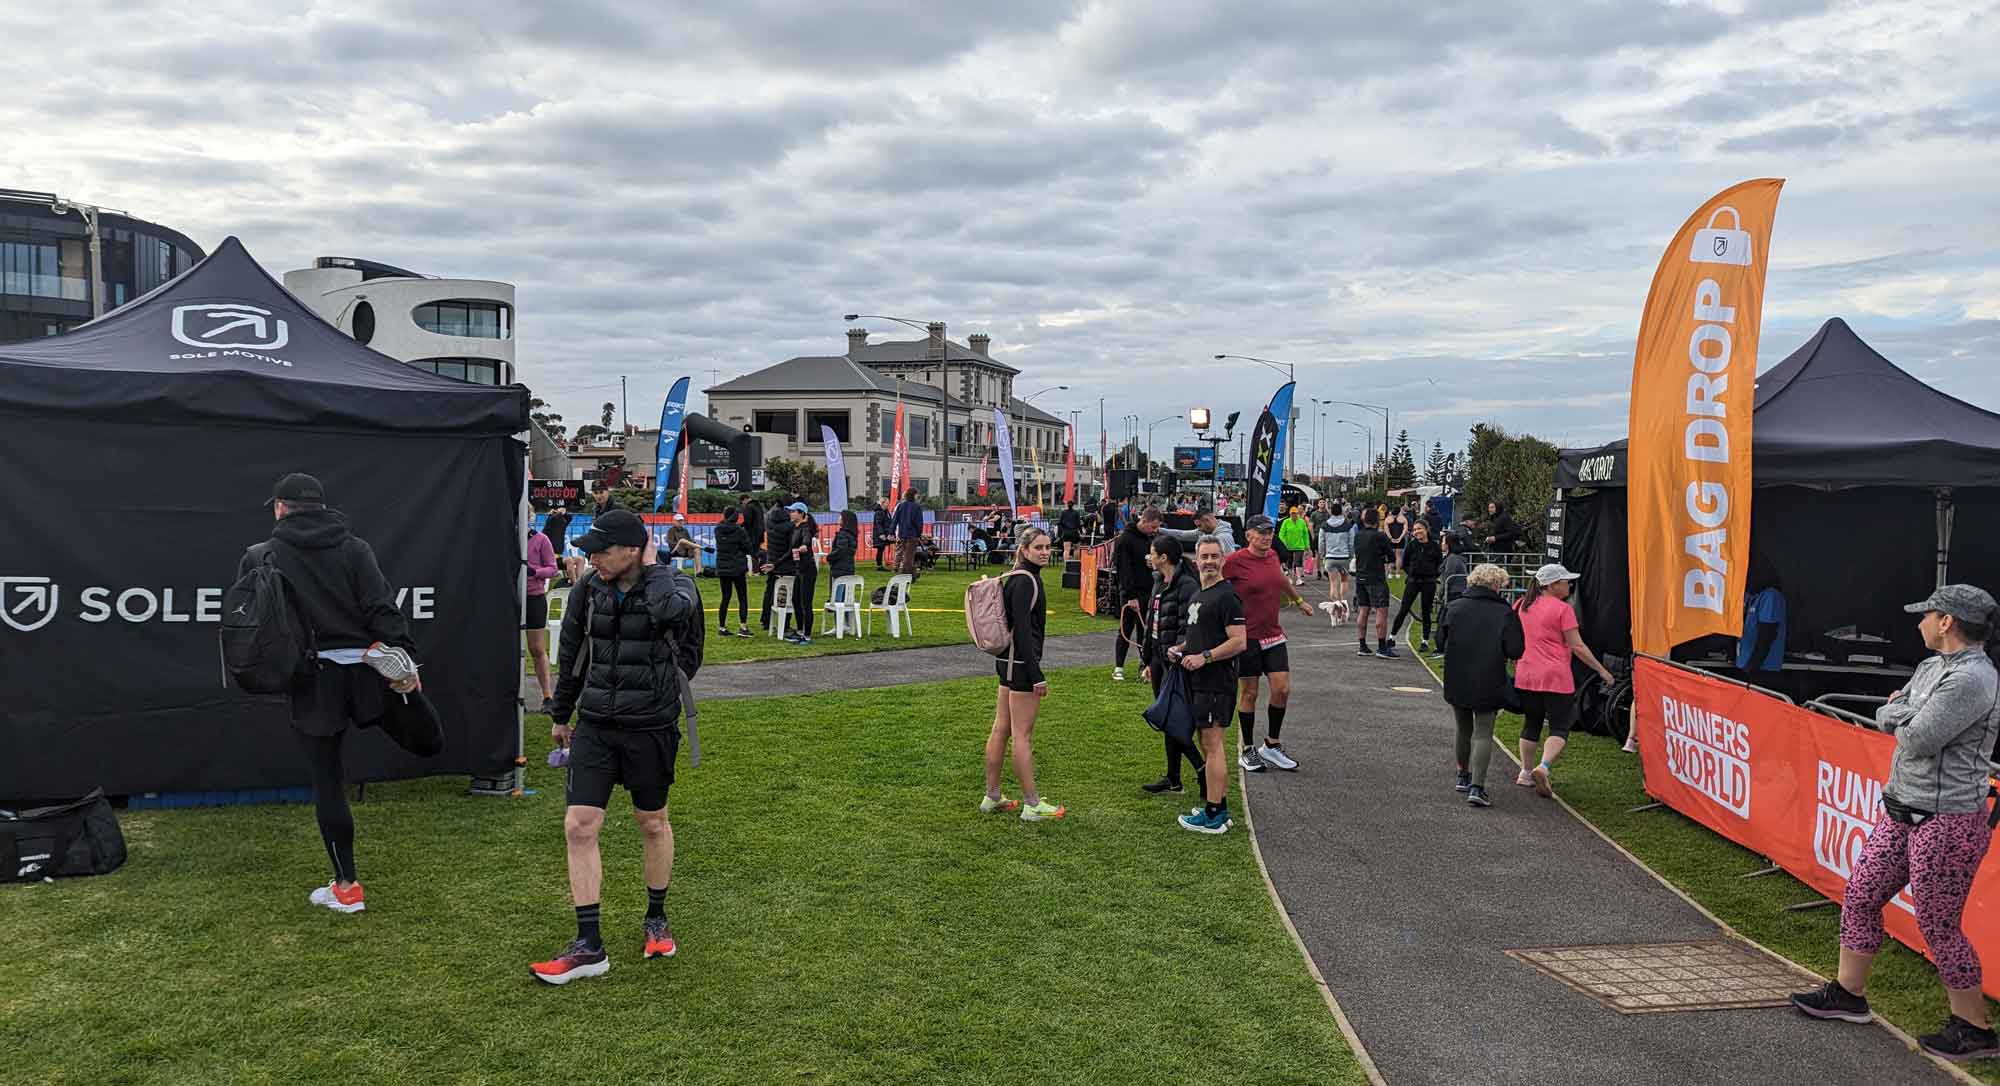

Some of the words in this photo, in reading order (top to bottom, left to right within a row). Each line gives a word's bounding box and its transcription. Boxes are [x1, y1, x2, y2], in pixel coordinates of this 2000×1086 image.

[169, 351, 217, 360] SOLE
[223, 350, 293, 367] MOTIVE
[1685, 278, 1736, 464] DROP
[553, 480, 564, 488] KM
[1593, 455, 1615, 481] DROP
[1683, 480, 1729, 615] BAG
[79, 586, 222, 622] SOLE
[1667, 732, 1747, 810] WORLD
[1817, 759, 1888, 824] RUNN
